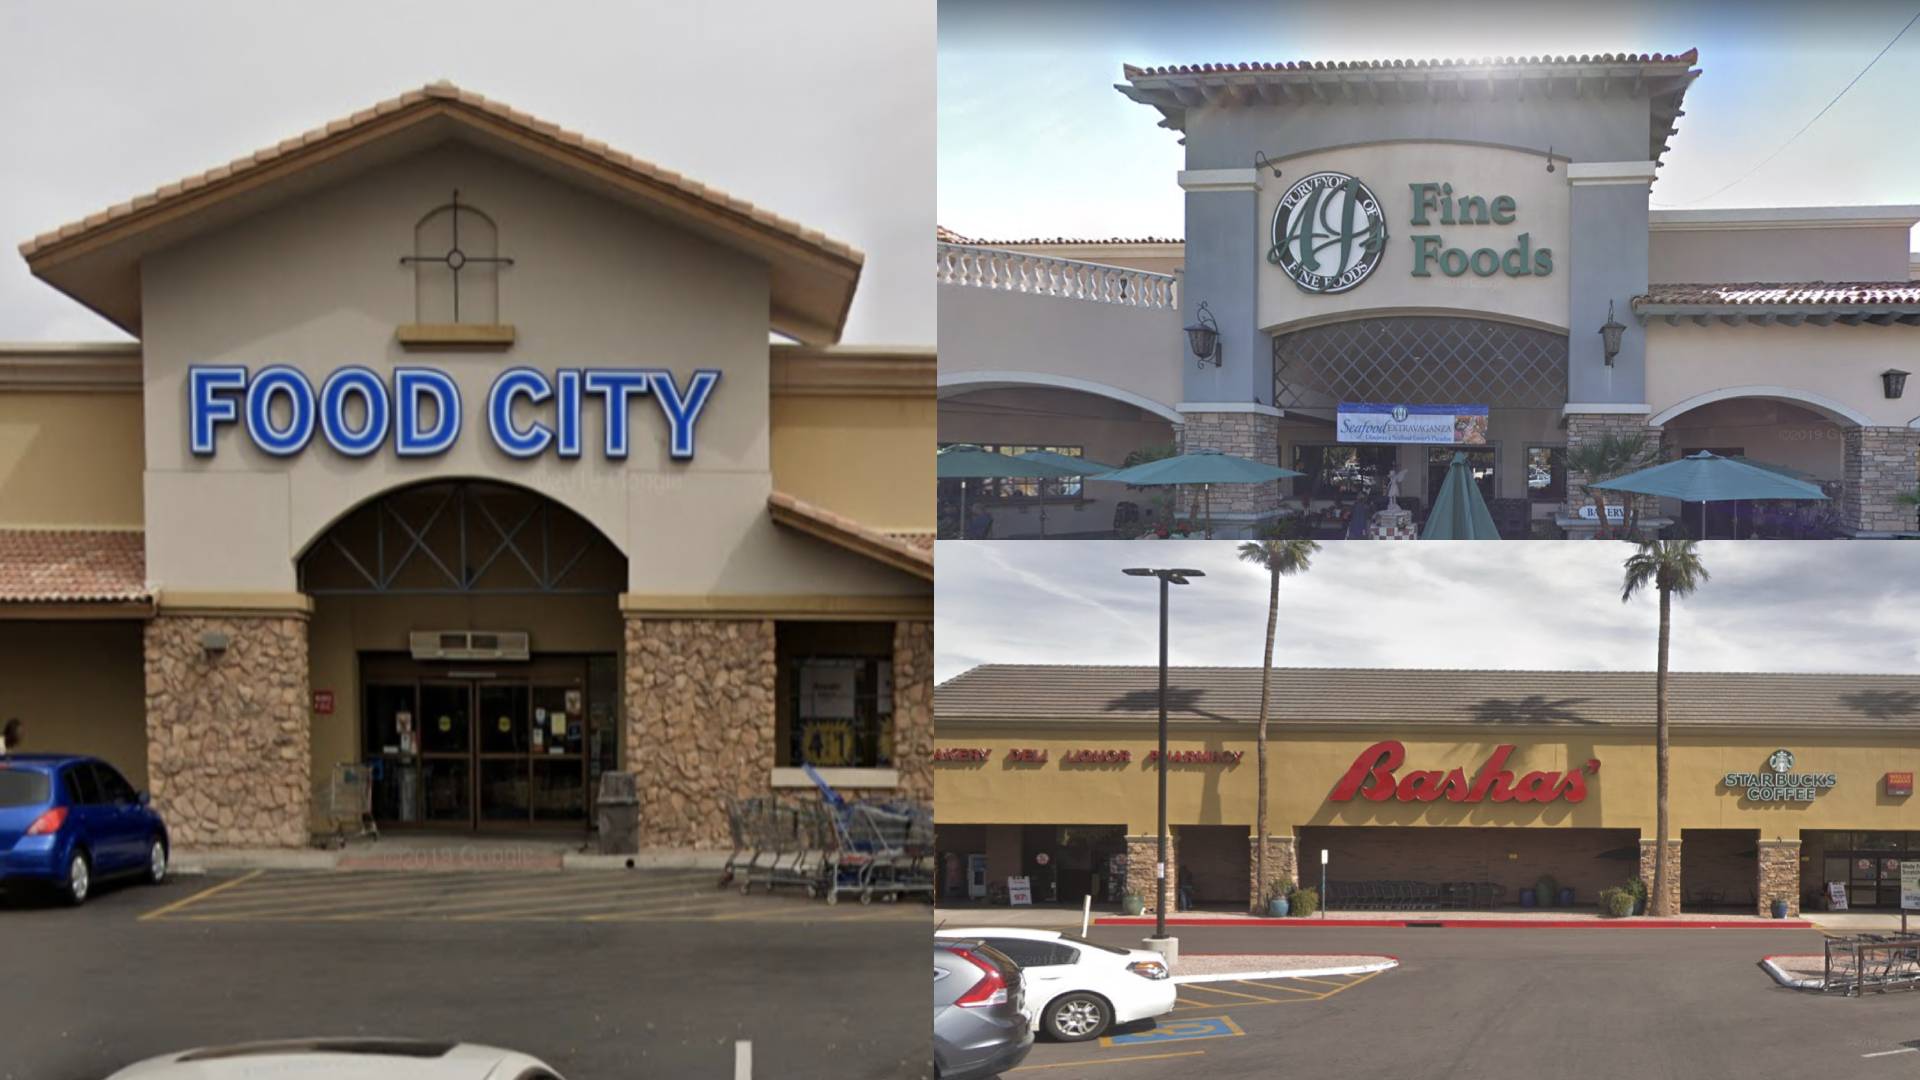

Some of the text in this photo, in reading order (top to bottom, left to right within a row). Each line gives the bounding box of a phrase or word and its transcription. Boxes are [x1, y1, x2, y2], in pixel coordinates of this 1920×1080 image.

[1283, 176, 1351, 210] PURVEYO
[1408, 181, 1517, 226] Fine
[1409, 232, 1554, 278] Foods
[1287, 262, 1320, 288] FNE
[187, 364, 722, 459] FOOD CITY
[1340, 418, 1452, 437] Seafood EXTRAVAGANZA
[1587, 508, 1625, 518] BERY
[1008, 748, 1048, 763] DELI
[1149, 750, 1245, 764] PARMACY
[1328, 739, 1601, 804] Bashas'
[1725, 772, 1837, 787] STARBUCKS
[1747, 787, 1816, 801] COFFEE
